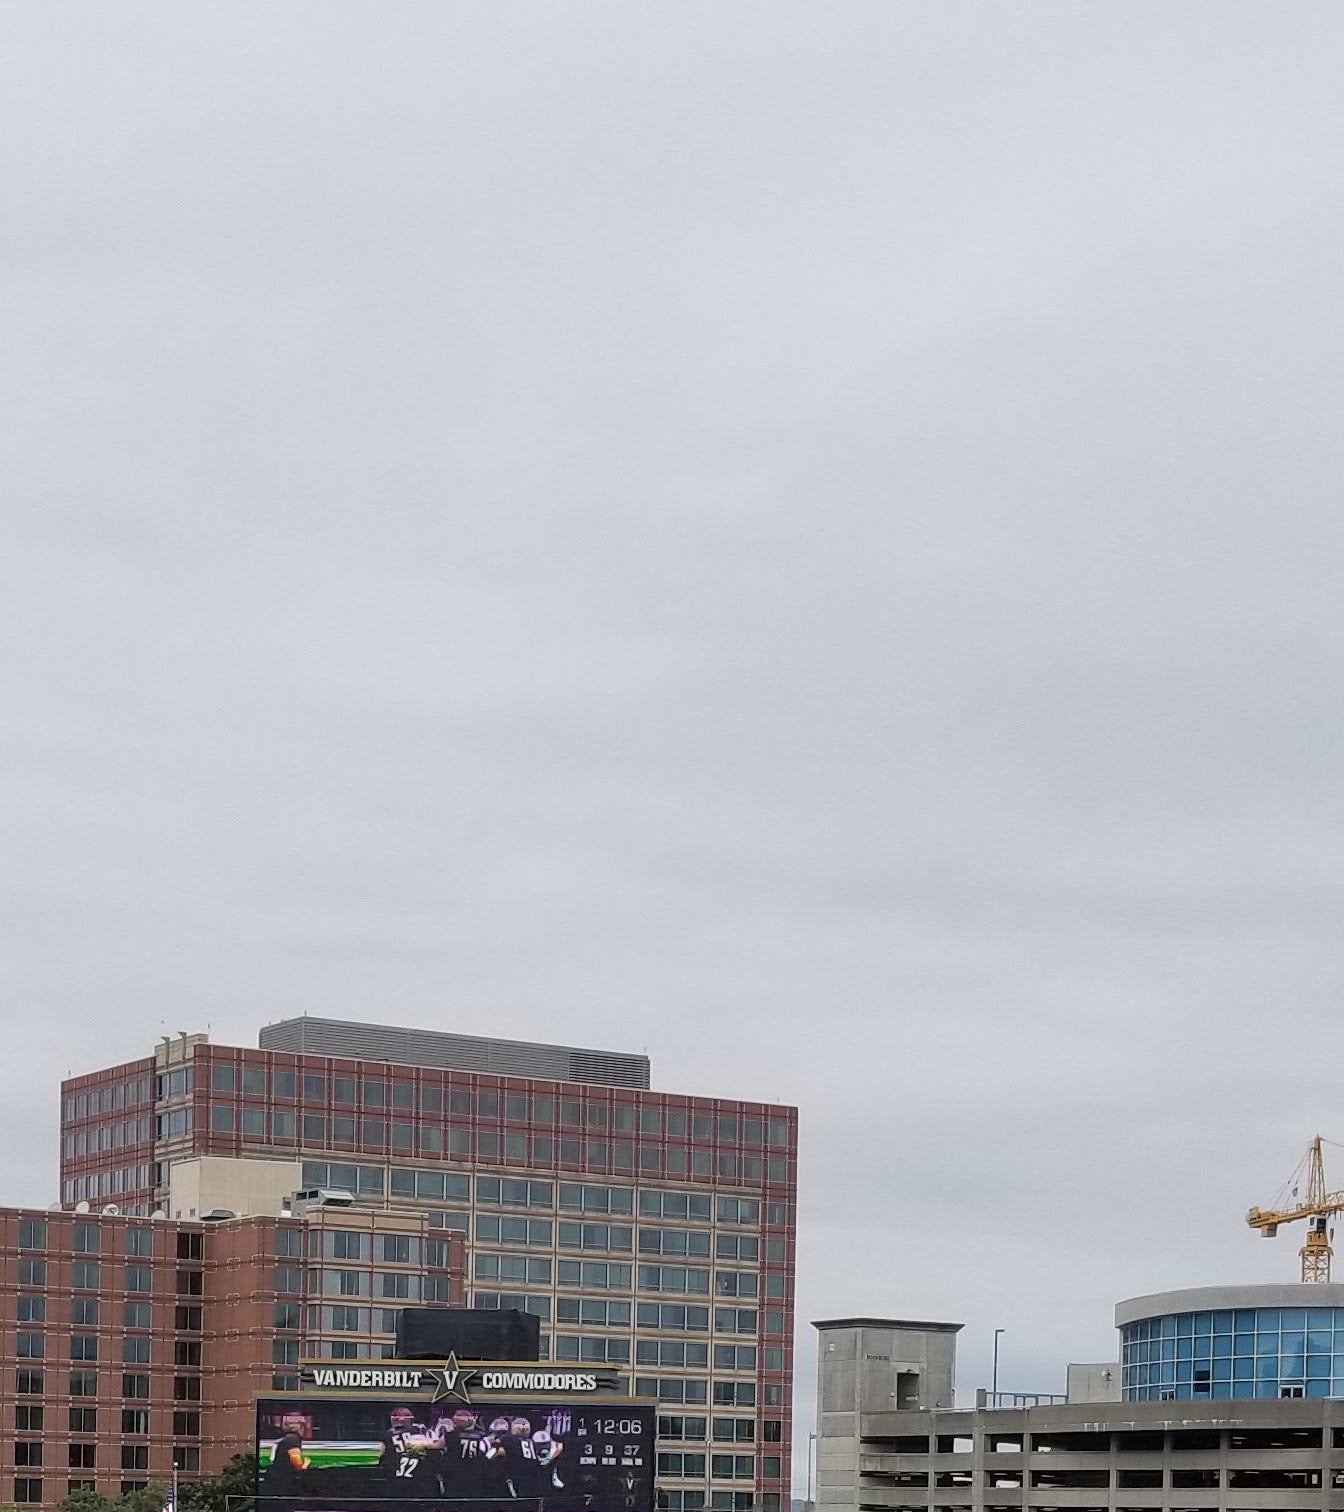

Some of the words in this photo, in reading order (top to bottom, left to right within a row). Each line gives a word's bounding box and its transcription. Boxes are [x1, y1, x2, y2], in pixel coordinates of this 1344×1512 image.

[313, 1370, 422, 1387] VANDERBILT
[443, 1371, 457, 1389] V
[482, 1372, 597, 1391] COMMODORES
[594, 1420, 642, 1434] 12:06
[521, 1440, 537, 1460] 61
[584, 1444, 593, 1455] 3
[604, 1444, 613, 1455] 9
[624, 1444, 641, 1456] 37
[395, 1457, 419, 1479] 32
